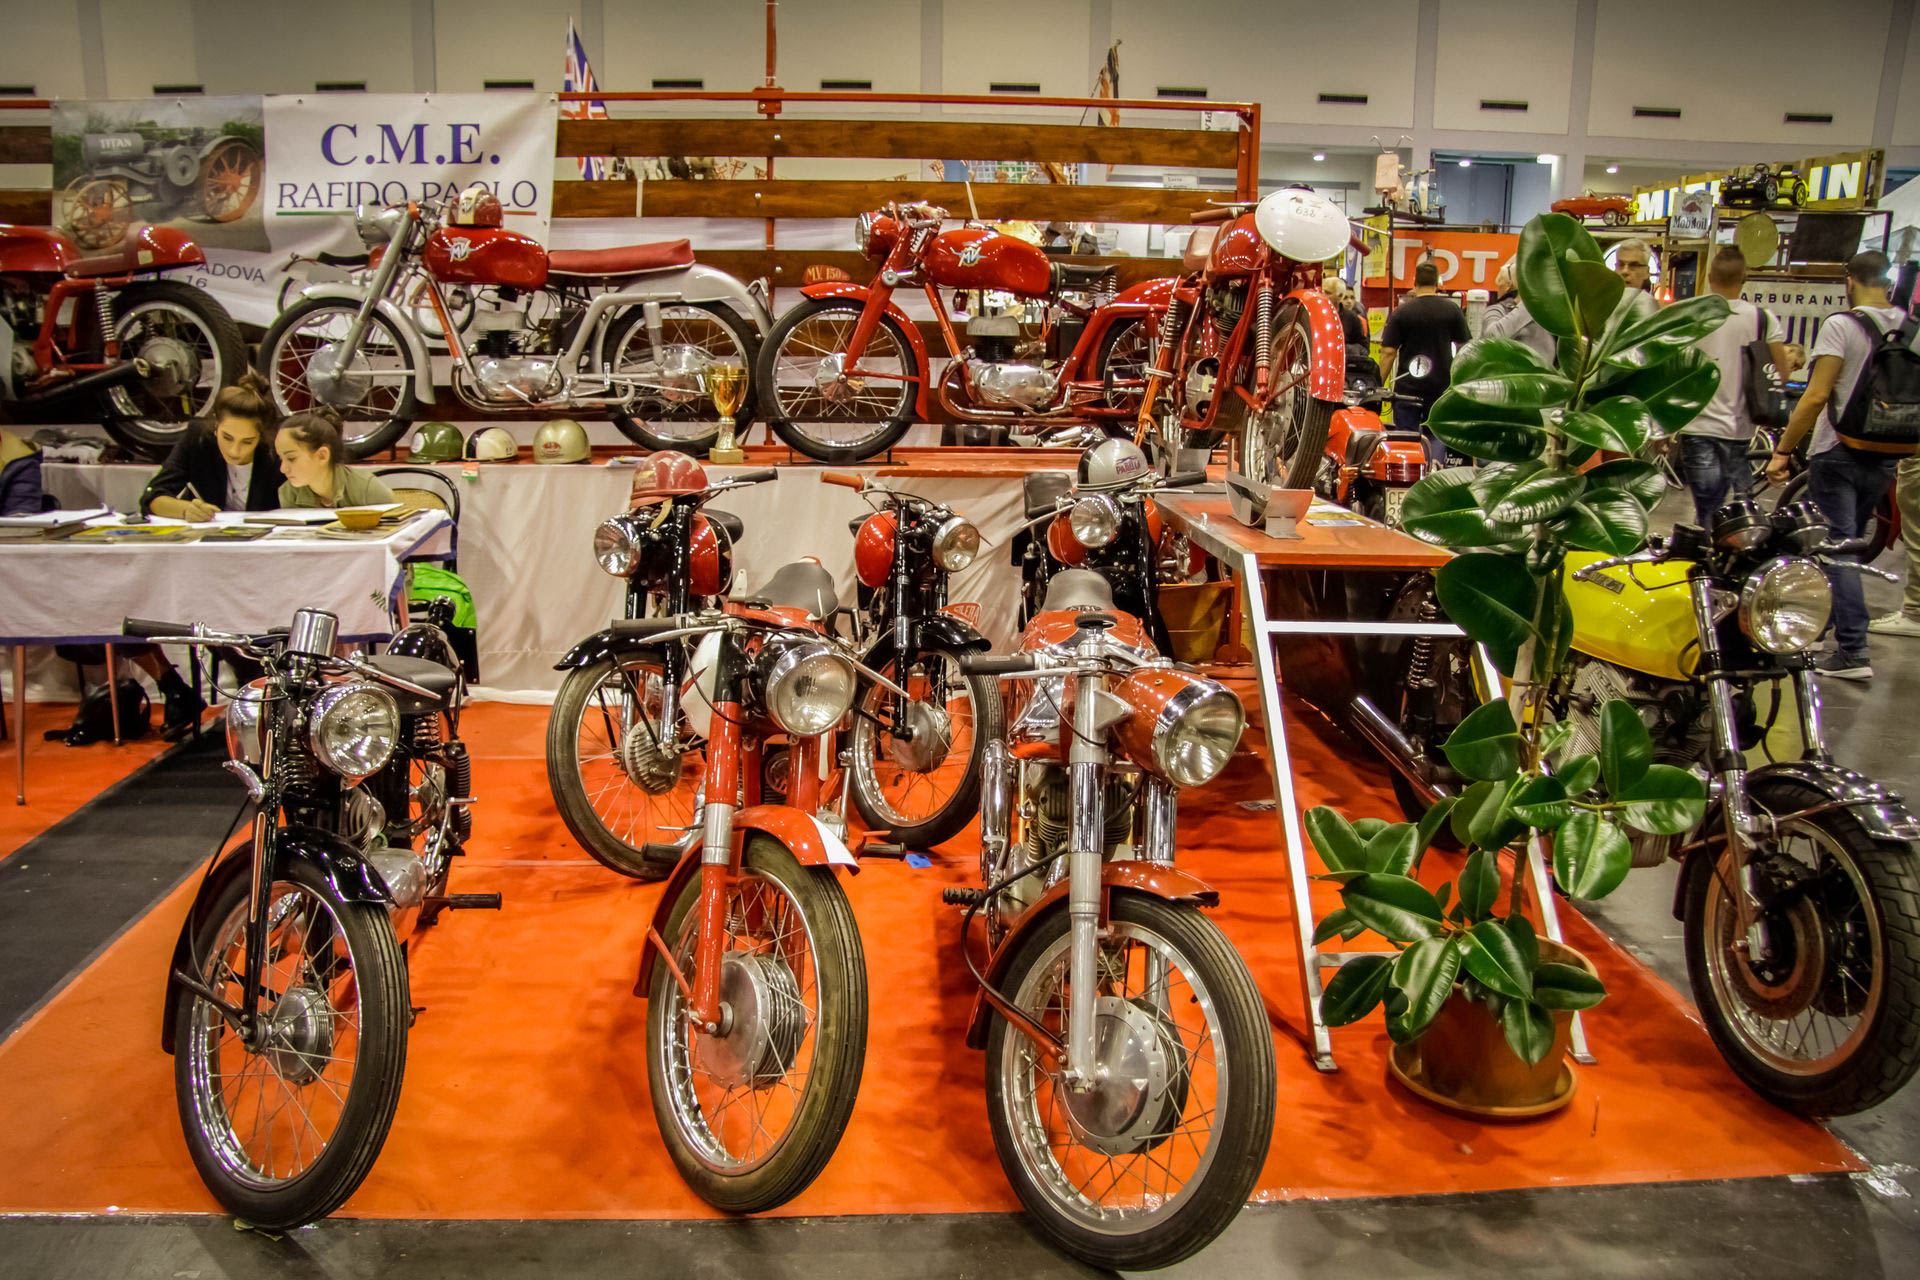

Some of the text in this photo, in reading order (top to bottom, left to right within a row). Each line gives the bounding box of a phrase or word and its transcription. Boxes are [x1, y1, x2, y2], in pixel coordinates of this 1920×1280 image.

[100, 137, 131, 149] TITAN
[321, 123, 501, 166] C.M.E.
[278, 181, 408, 208] RAFIDO
[196, 263, 265, 282] ADOVA
